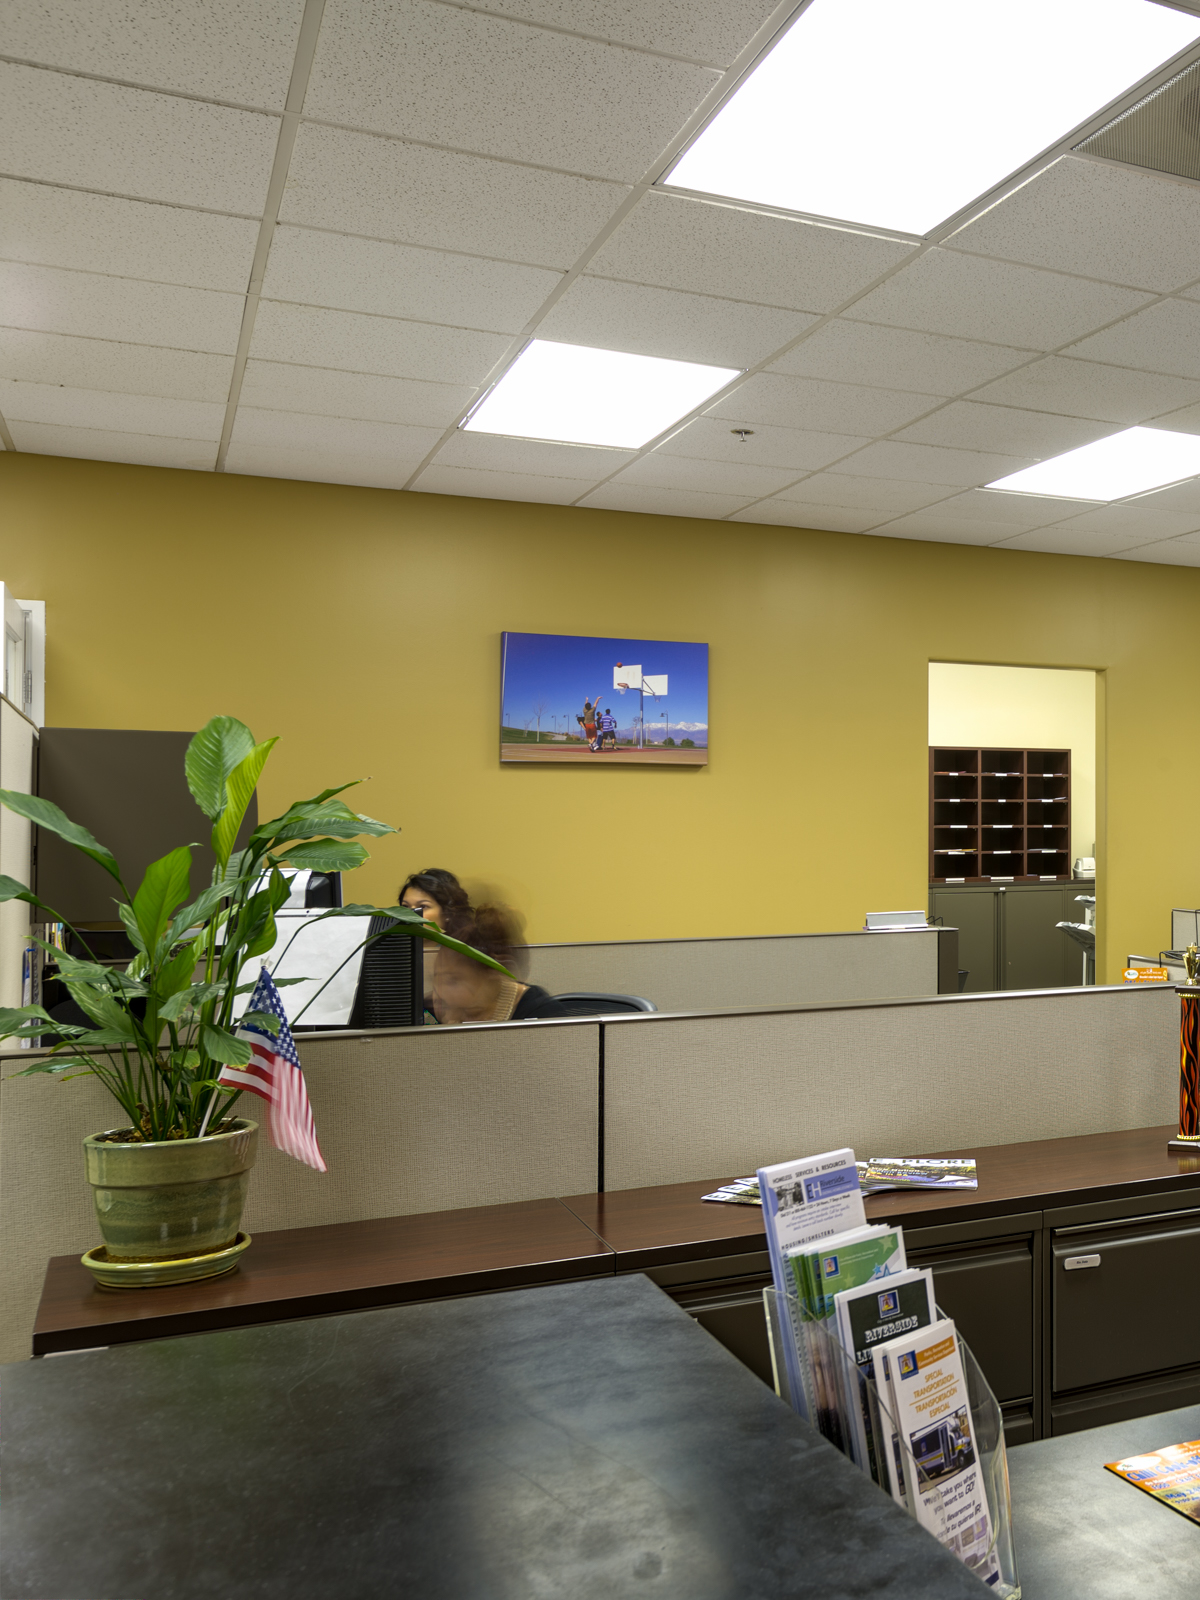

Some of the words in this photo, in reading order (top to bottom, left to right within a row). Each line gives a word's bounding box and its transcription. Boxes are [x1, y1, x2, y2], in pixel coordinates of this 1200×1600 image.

[773, 1174, 792, 1184] HOMELESS
[795, 1169, 814, 1178] SERVICES
[822, 1160, 846, 1170] RESOURCES
[821, 1175, 845, 1187] Riverside
[782, 1229, 834, 1250] HOUSING/SHELTERS
[865, 1315, 918, 1343] RIVERSIDE
[925, 1368, 943, 1383] SPECIAL
[914, 1373, 955, 1398] TRANSPORTATION
[929, 1402, 950, 1418] ESPECIAL
[1126, 1466, 1158, 1481] Chili
[940, 1485, 953, 1497] take
[954, 1481, 963, 1493] you
[963, 1471, 977, 1486] where
[944, 1496, 958, 1508] want
[965, 1480, 975, 1495] GO!
[1166, 1492, 1186, 1500] May
[958, 1512, 974, 1527] quieras
